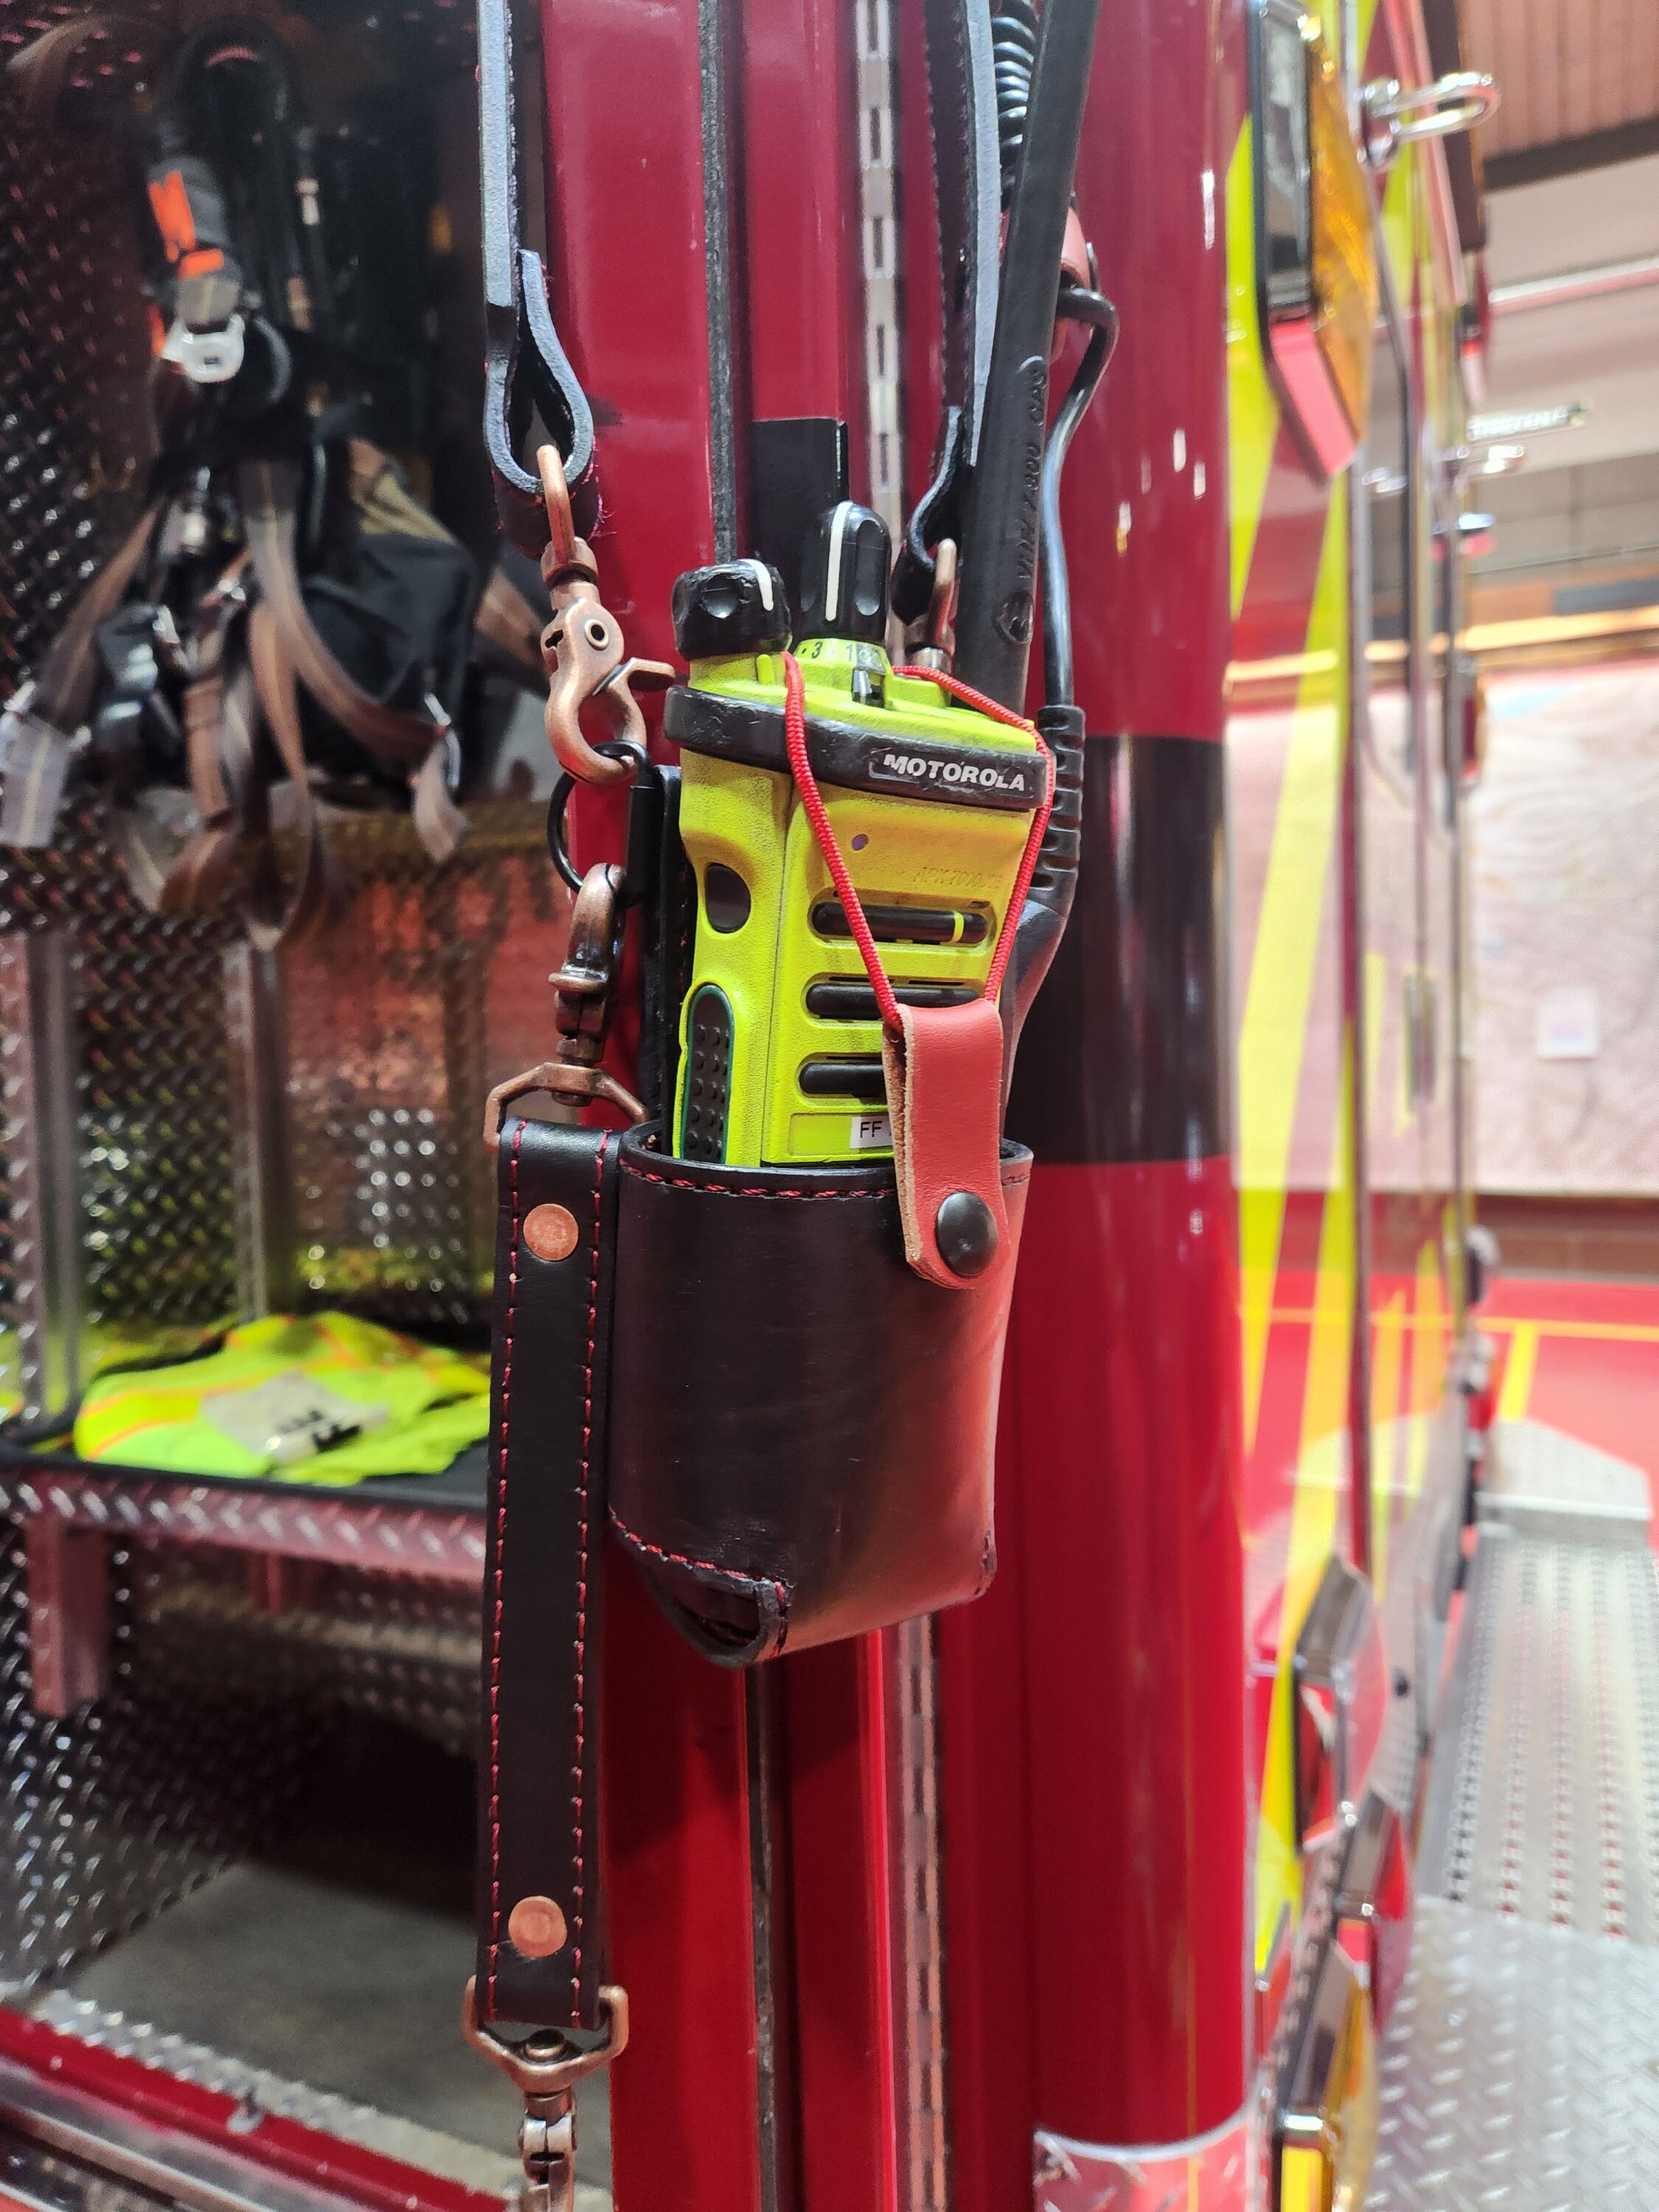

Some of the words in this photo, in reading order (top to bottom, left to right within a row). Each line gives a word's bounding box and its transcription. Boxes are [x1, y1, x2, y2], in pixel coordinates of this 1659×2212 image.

[812, 641, 823, 658] 3
[846, 644, 854, 662] 1
[883, 754, 1025, 792] MOTOROLA
[860, 1120, 883, 1138] FF
